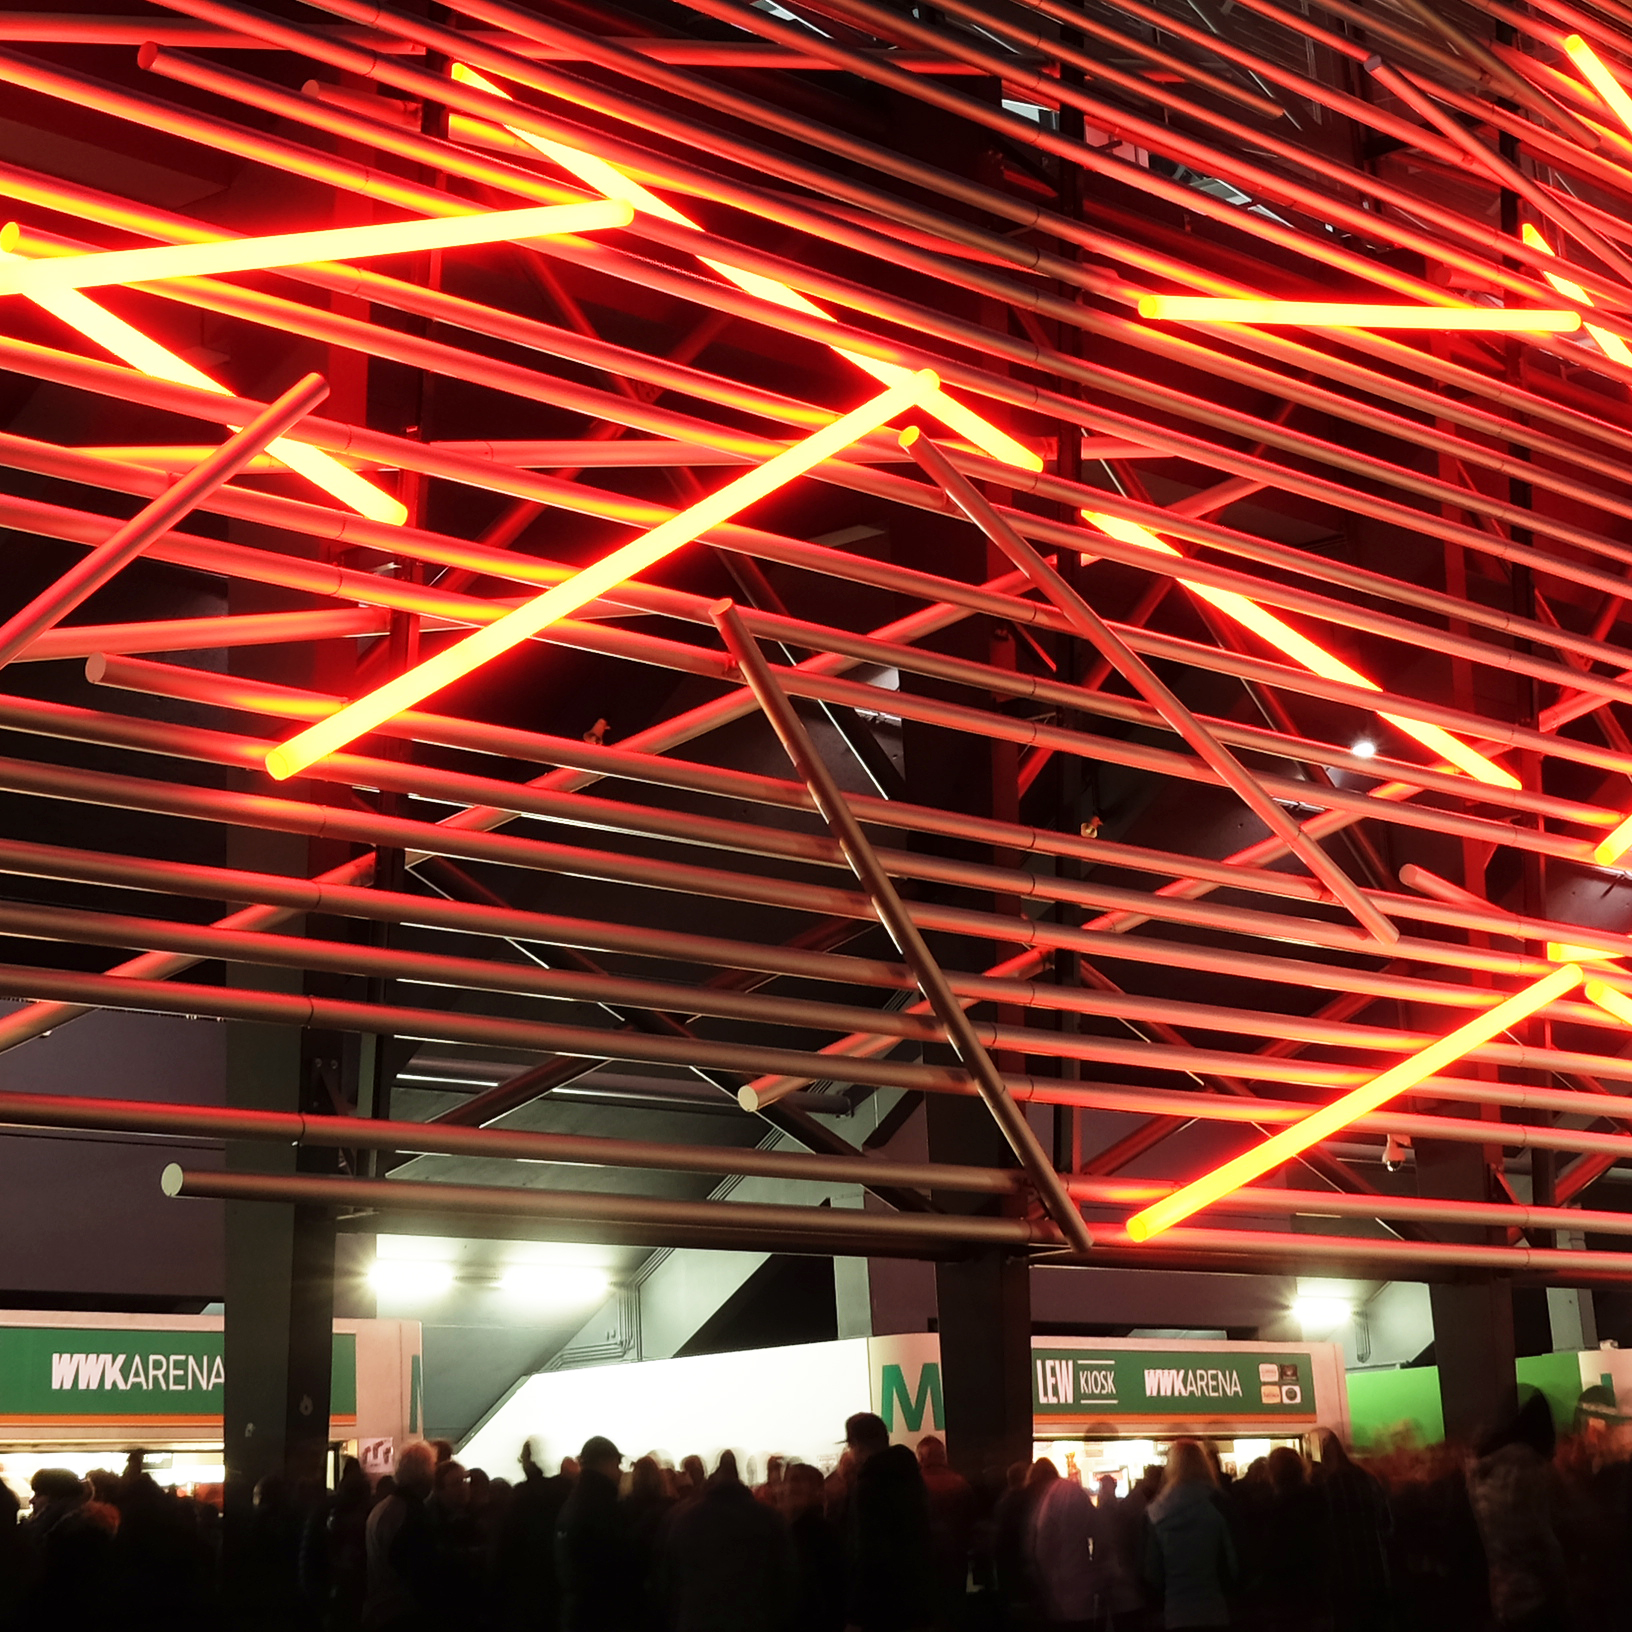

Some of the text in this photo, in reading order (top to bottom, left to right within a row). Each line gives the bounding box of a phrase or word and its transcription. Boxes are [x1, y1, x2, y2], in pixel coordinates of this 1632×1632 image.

[881, 1363, 946, 1433] M
[1036, 1359, 1074, 1404] LEW
[1079, 1370, 1116, 1395] KIOSK
